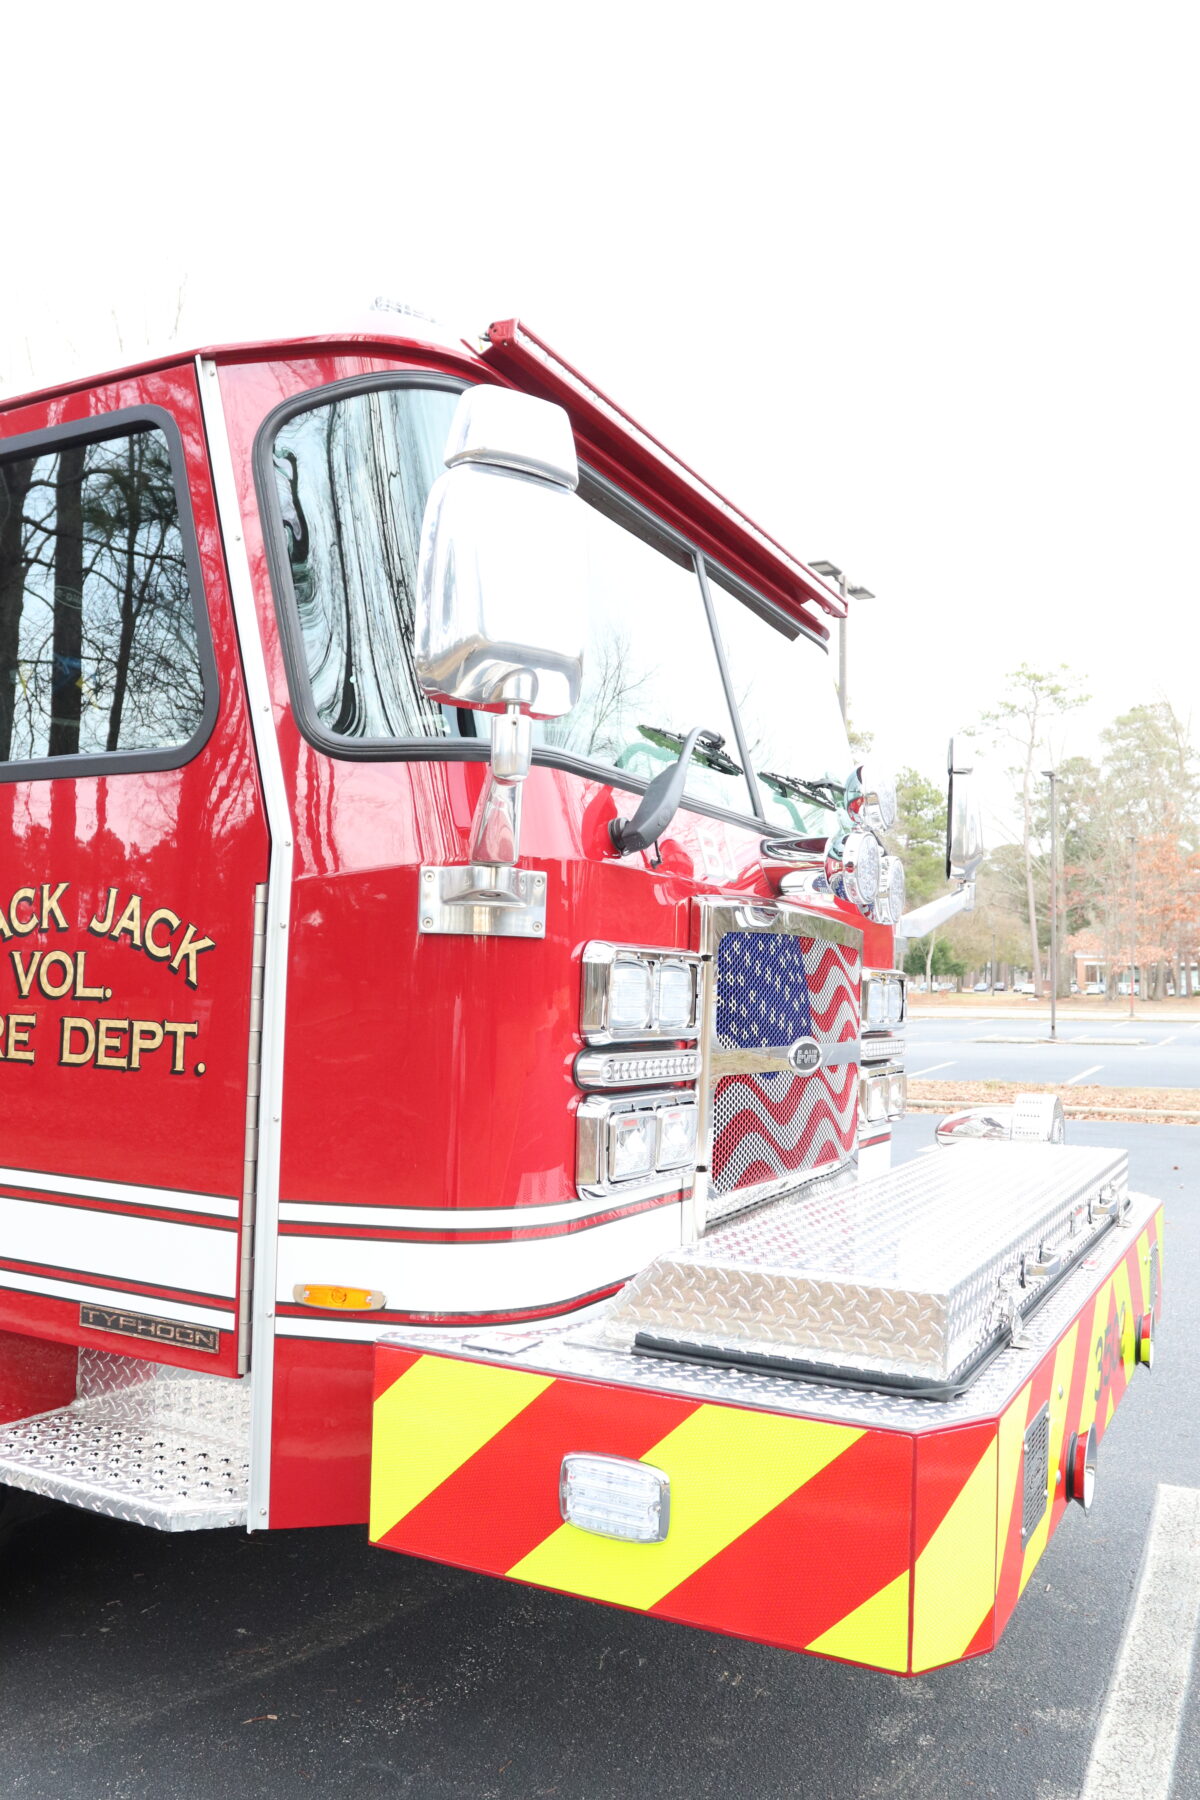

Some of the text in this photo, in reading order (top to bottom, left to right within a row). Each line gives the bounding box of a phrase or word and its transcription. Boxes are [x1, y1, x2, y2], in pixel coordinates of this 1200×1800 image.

[90, 887, 216, 990] JACK
[10, 950, 112, 1000] VOL.
[58, 1015, 206, 1076] DEPT.
[87, 1310, 214, 1347] TYPHOON
